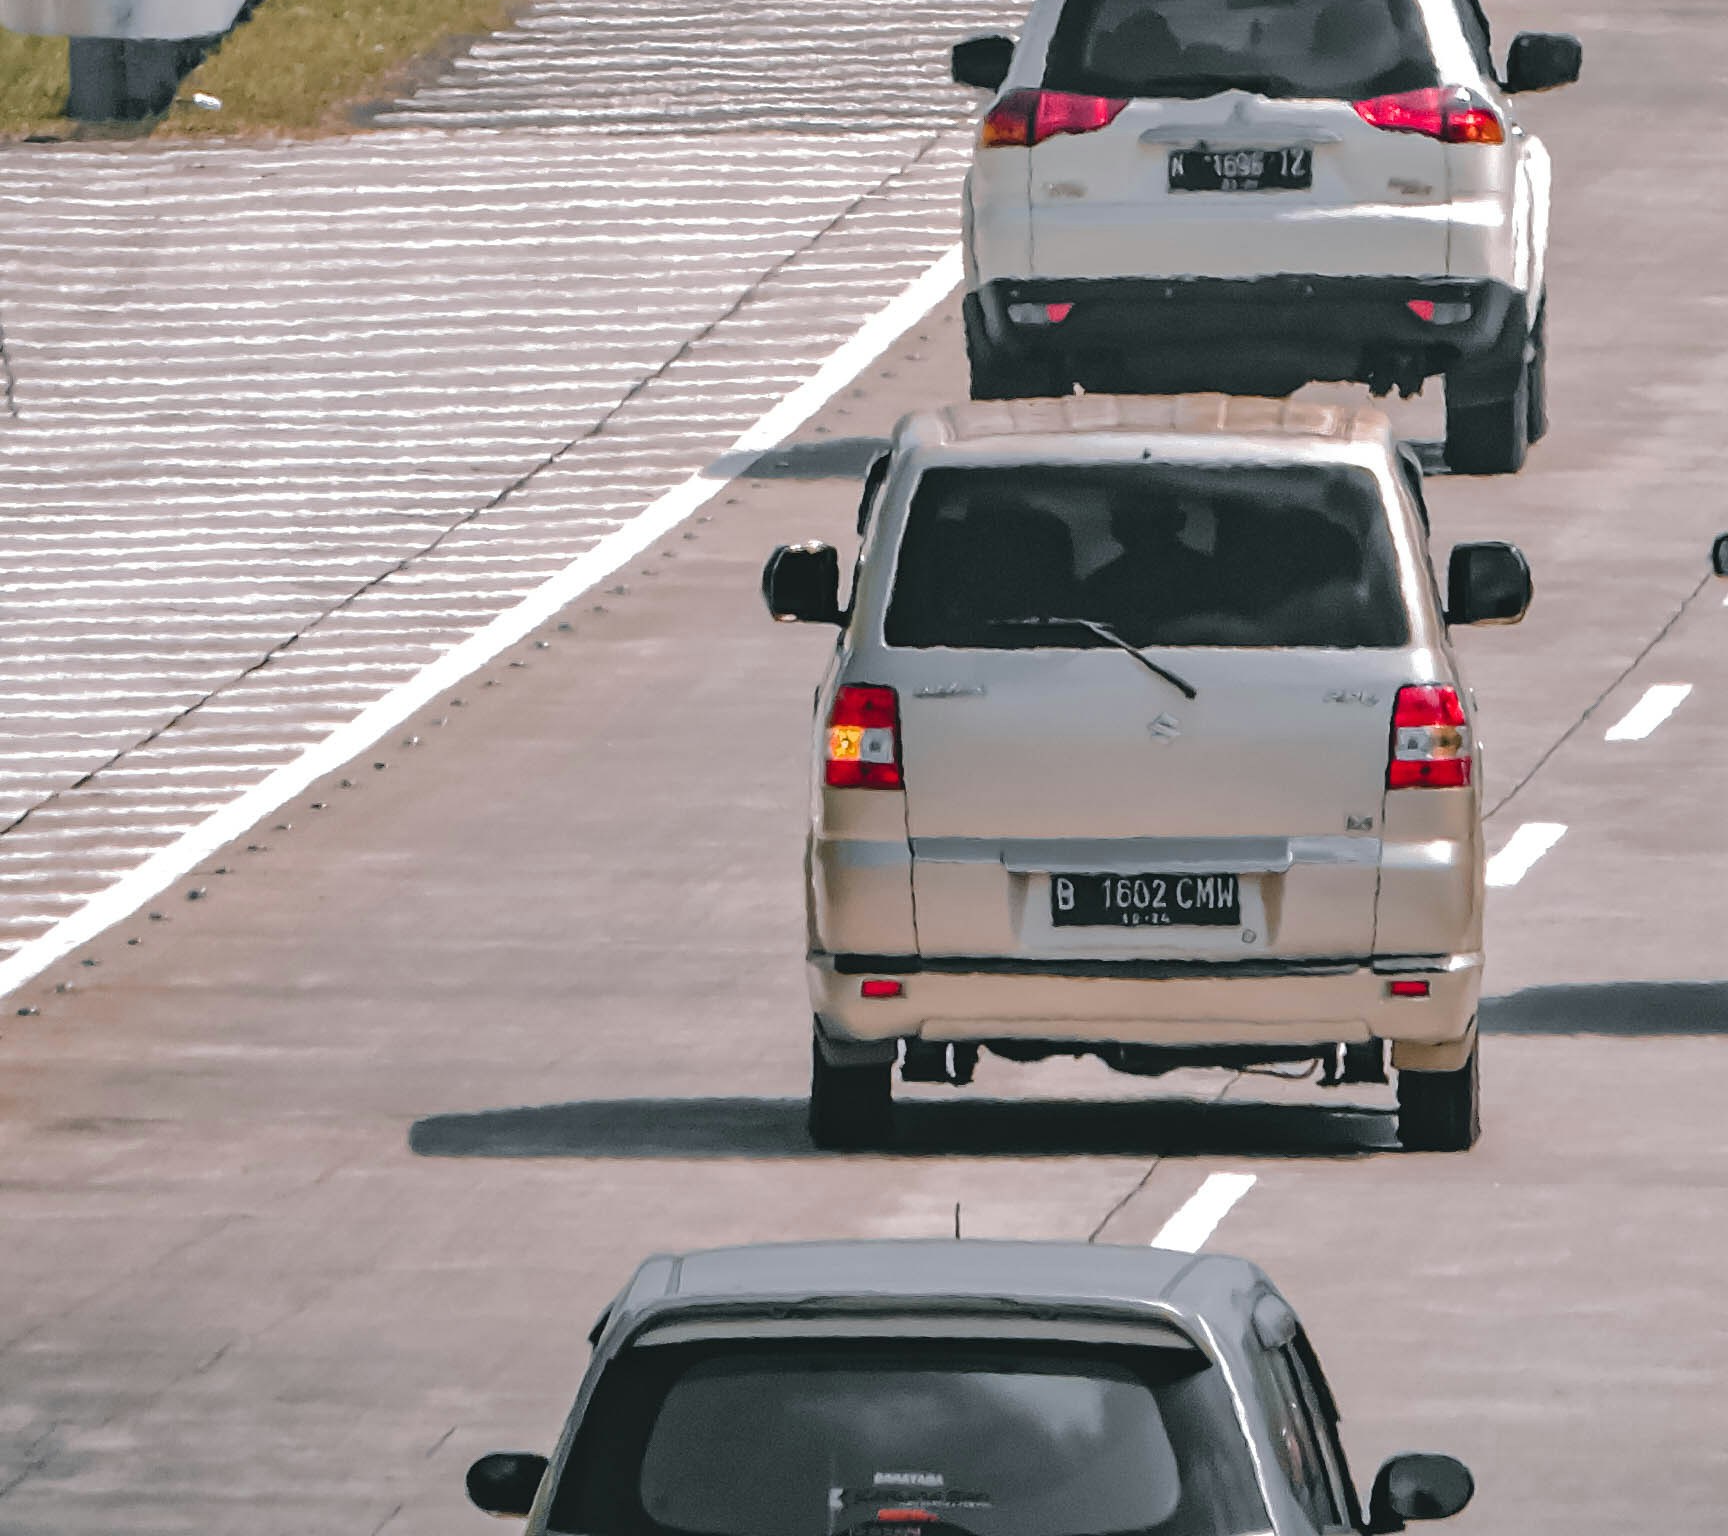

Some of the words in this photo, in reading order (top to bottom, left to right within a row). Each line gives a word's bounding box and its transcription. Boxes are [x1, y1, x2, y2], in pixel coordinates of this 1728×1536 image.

[1056, 878, 1075, 911] B
[1103, 878, 1168, 911] 1602
[1176, 878, 1234, 910] CMW
